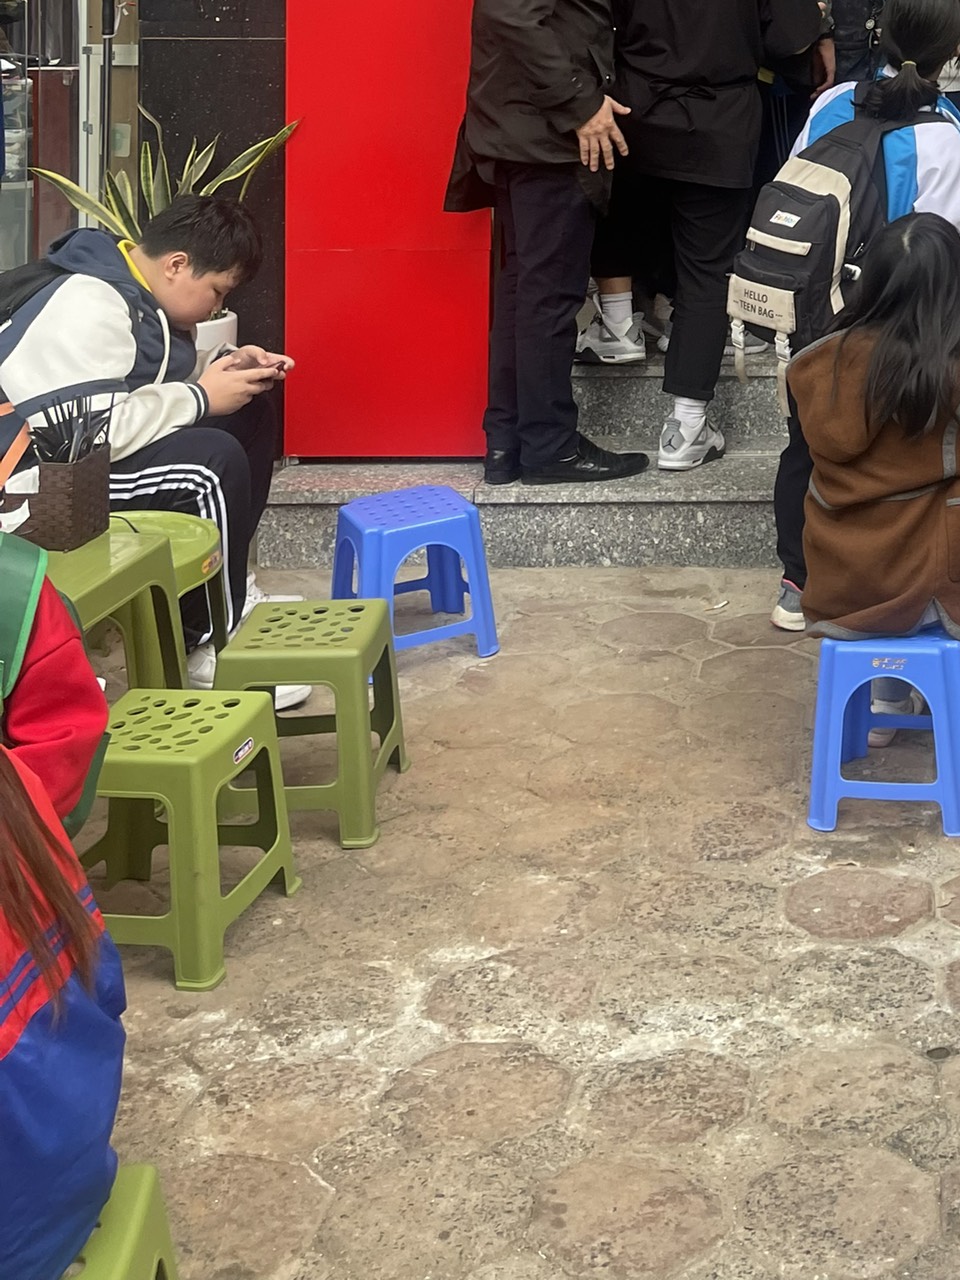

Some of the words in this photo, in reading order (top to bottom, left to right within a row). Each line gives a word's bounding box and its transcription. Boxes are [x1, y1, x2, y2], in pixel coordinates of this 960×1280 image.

[743, 288, 768, 304] HELLO
[739, 300, 757, 314] TEEN
[757, 306, 774, 319] BAG
